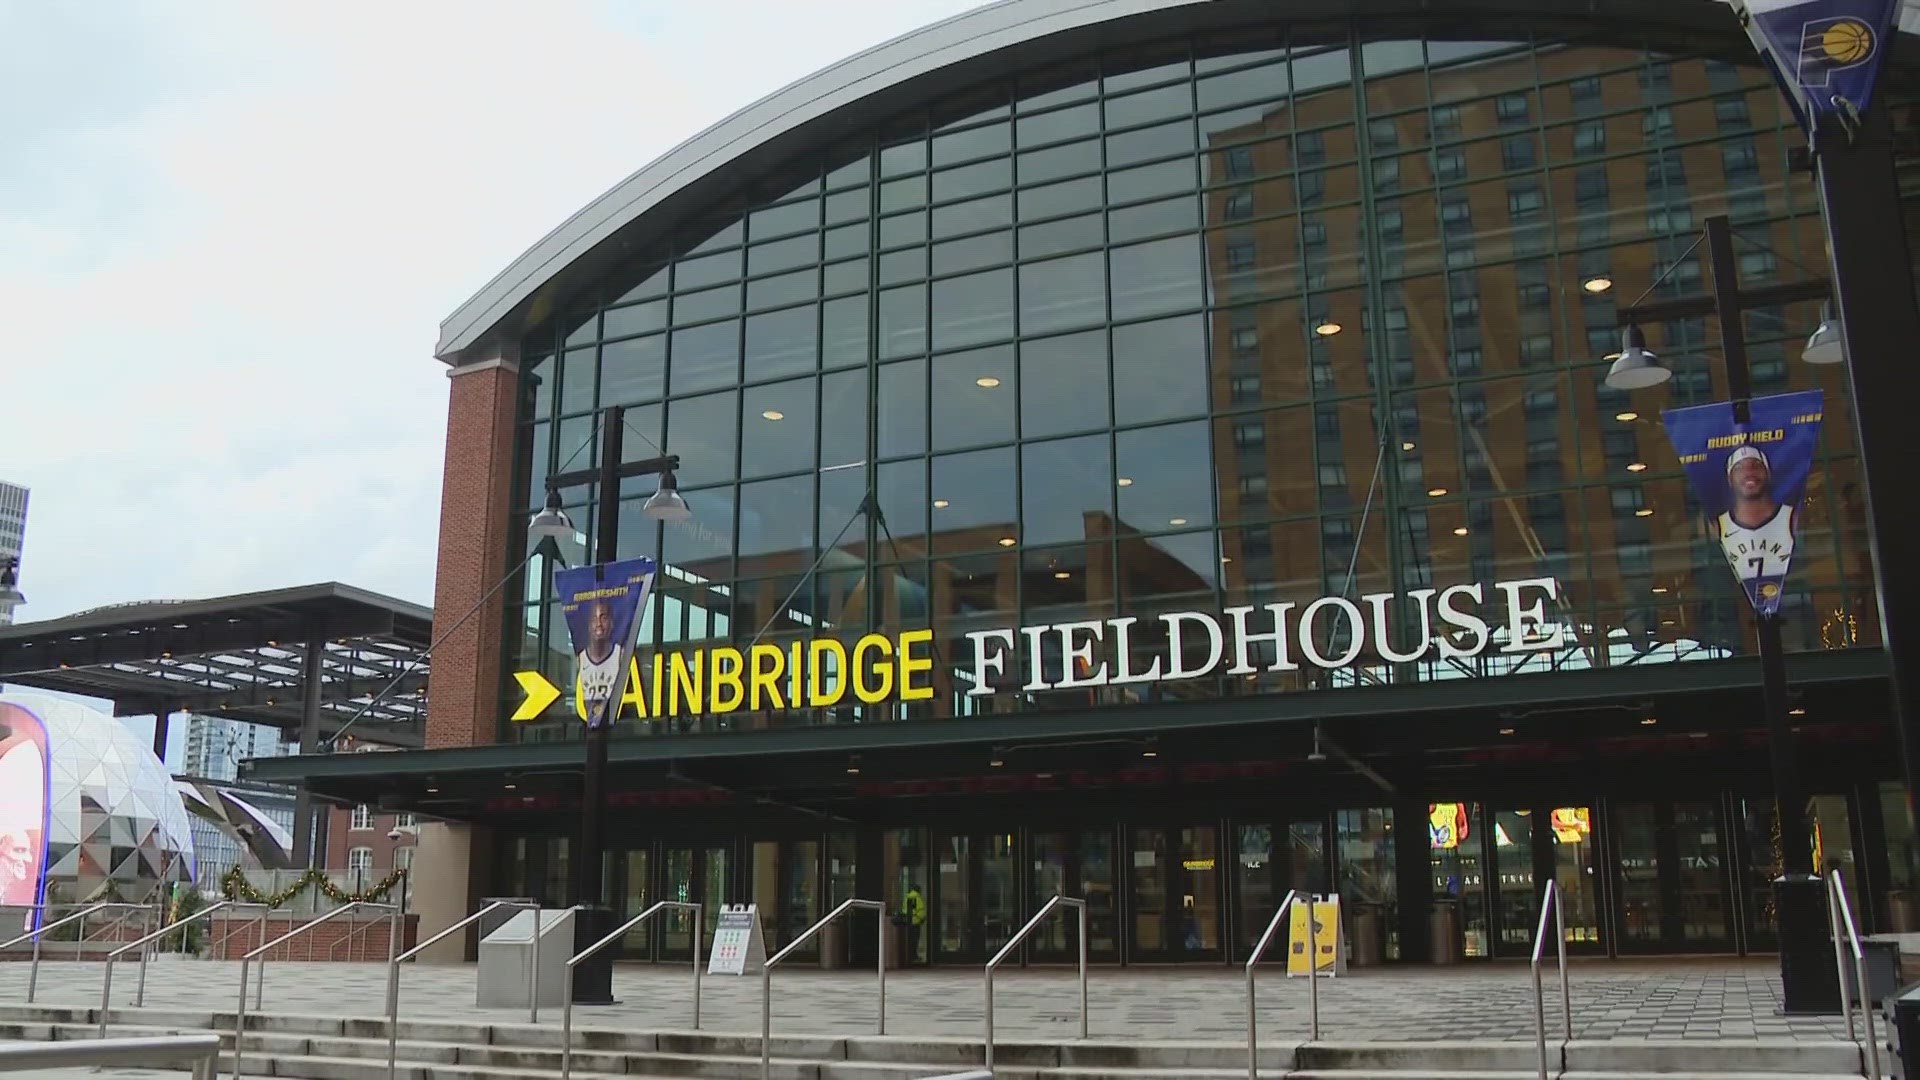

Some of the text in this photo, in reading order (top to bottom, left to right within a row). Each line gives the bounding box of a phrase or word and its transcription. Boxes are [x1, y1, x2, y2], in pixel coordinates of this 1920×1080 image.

[1708, 429, 1784, 449] BUDDY HIELD
[1748, 556, 1764, 577] 7
[965, 576, 1563, 696] FIELDHOUSE
